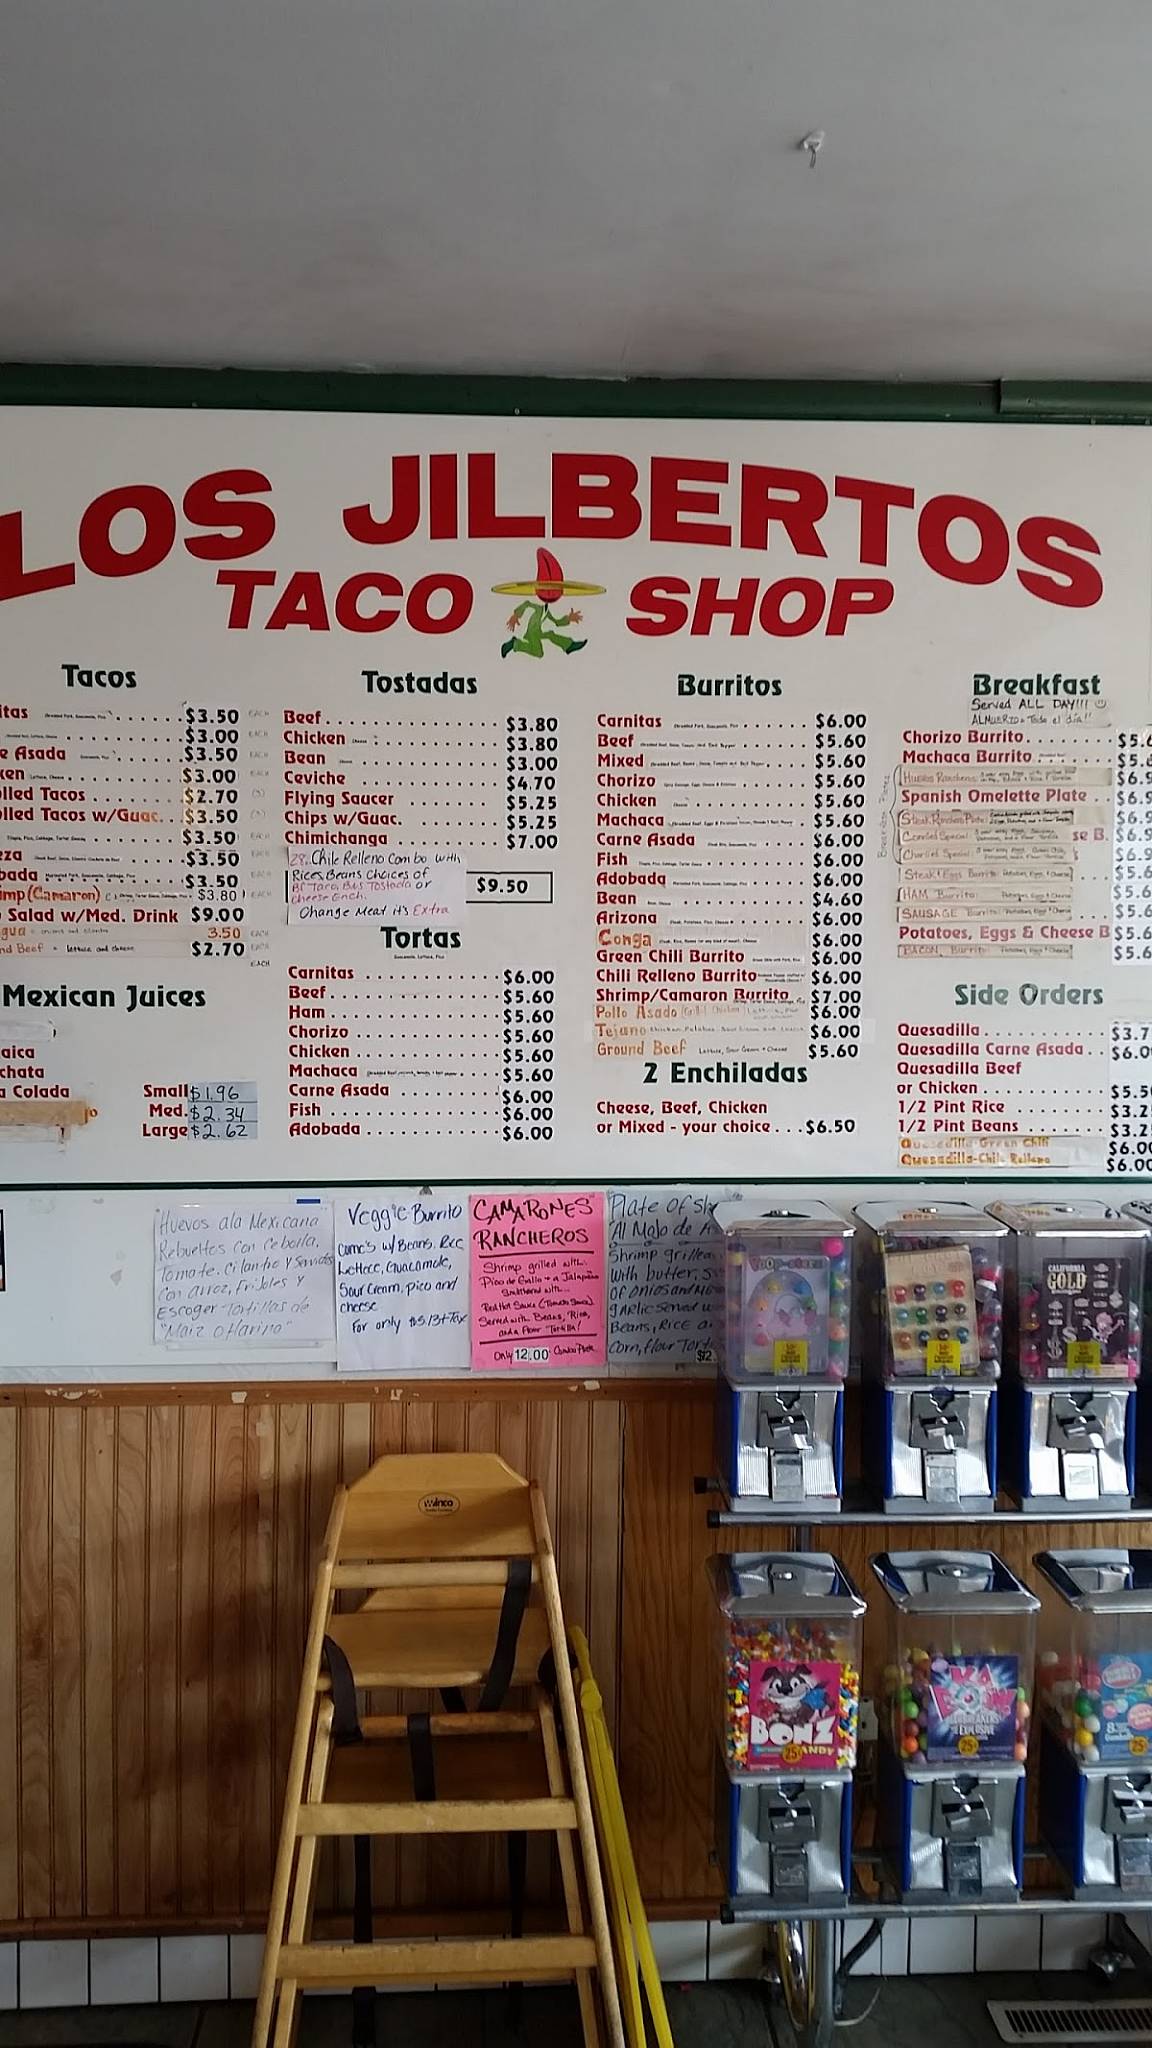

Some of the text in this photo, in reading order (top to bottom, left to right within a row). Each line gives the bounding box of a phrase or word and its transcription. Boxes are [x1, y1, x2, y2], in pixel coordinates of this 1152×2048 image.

[0, 451, 1105, 610] LOS JILBERTOS
[214, 568, 894, 639] TACO SHOP
[61, 664, 137, 688] Tacos
[361, 670, 478, 694] Tostadas
[677, 674, 782, 697] Burritos
[973, 674, 1101, 697] Breakfast
[971, 699, 1011, 711] Served
[1018, 699, 1044, 710] ALL
[284, 710, 558, 733] Beef $3.80
[596, 714, 662, 728] Carnitas
[815, 713, 867, 729] $6.00
[283, 730, 558, 752] Chicken $3.80
[597, 734, 634, 748] Beef
[903, 730, 1023, 744] Chorizo Burrito
[14, 746, 238, 763] Asada $3.50
[284, 750, 558, 772] Bean $3.00
[597, 753, 644, 768] Mixed
[902, 750, 1032, 763] Machaca Burrito
[284, 770, 556, 792] Ceviche $4.70
[597, 773, 656, 788] Chorizo
[40, 787, 238, 805] Tacos $2.70
[284, 791, 557, 811] Flying Saucer $5.25
[597, 793, 657, 808] Chicken
[902, 789, 1087, 806] Spanish Omelette Plate
[41, 808, 87, 822] Tacos
[185, 809, 238, 825] $3.50
[284, 811, 403, 827] Chips w/Guac.
[597, 813, 664, 827] Machaca
[284, 831, 558, 850] Chimichanga $7.00
[596, 832, 642, 847] Carne
[647, 833, 696, 848] Asada
[311, 849, 385, 866] Chile Relleno
[597, 852, 628, 867] Fish
[477, 876, 528, 894] $9.50
[596, 872, 666, 887] Adobada
[596, 892, 863, 907] Bean $4.60
[902, 889, 929, 900] HAM
[8, 907, 244, 924] Salad w/Med. Drink $9.00
[300, 905, 350, 919] Change
[413, 903, 449, 917] Extra
[596, 911, 657, 925] Arizona
[207, 927, 241, 939] 3.50
[380, 926, 462, 949] Tortas
[599, 928, 652, 949] Conga
[899, 926, 1093, 941] Potatoes, Eggs & Cheese
[191, 943, 245, 957] $2.70
[596, 949, 745, 964] Green Chili Burrito
[288, 966, 555, 986] Carnitas $6.00
[596, 969, 631, 983] Chili
[637, 969, 696, 984] Relleno
[702, 968, 757, 982] Burrito
[2, 984, 206, 1013] Mexican Juices
[289, 986, 326, 1000] Beef
[596, 988, 728, 1005] Shrimp/Camaron
[733, 988, 789, 1001] Burrito
[811, 990, 861, 1004] $7.00
[955, 983, 1104, 1006] Side Orders
[289, 1005, 326, 1020] Ham
[596, 1005, 627, 1019] Pollo
[636, 1005, 678, 1019] Asado
[289, 1025, 349, 1039] Chorizo
[898, 1023, 980, 1037] Quesadilla
[289, 1044, 350, 1059] Chicken
[597, 1039, 687, 1056] Ground Beef
[897, 1042, 1084, 1056] Quesadilla Carne Asada
[289, 1064, 358, 1078] Machaca
[643, 1062, 808, 1084] 2 Enchiladas
[897, 1062, 1022, 1075] Quesadilla Beef
[143, 1084, 240, 1101] Small $1.96
[289, 1083, 389, 1098] Carne Asada
[897, 1081, 978, 1094] or Chicken
[149, 1104, 245, 1122] Med. $2.34
[289, 1103, 321, 1117] Fish
[596, 1101, 768, 1116] Cheese, Beef, Chicken
[899, 1100, 1005, 1114] 1/2 Pint Rice
[142, 1124, 248, 1140] Large $2.62
[289, 1122, 361, 1137] Adobada
[596, 1120, 855, 1136] or Mixed your choice $6.50
[899, 1119, 1019, 1133] 1/2 Pint Beans
[473, 1197, 594, 1225] CAMARONES
[610, 1194, 658, 1220] Plate
[348, 1202, 462, 1232] Veggie Burrito
[473, 1227, 589, 1251] RANCHEROS
[483, 1259, 557, 1275] Shrimp grilled
[1047, 1272, 1087, 1290] GOLD
[494, 1348, 549, 1365] Only 12.00
[751, 1714, 836, 1746] BONZ
[801, 1746, 835, 1756] ANDY
